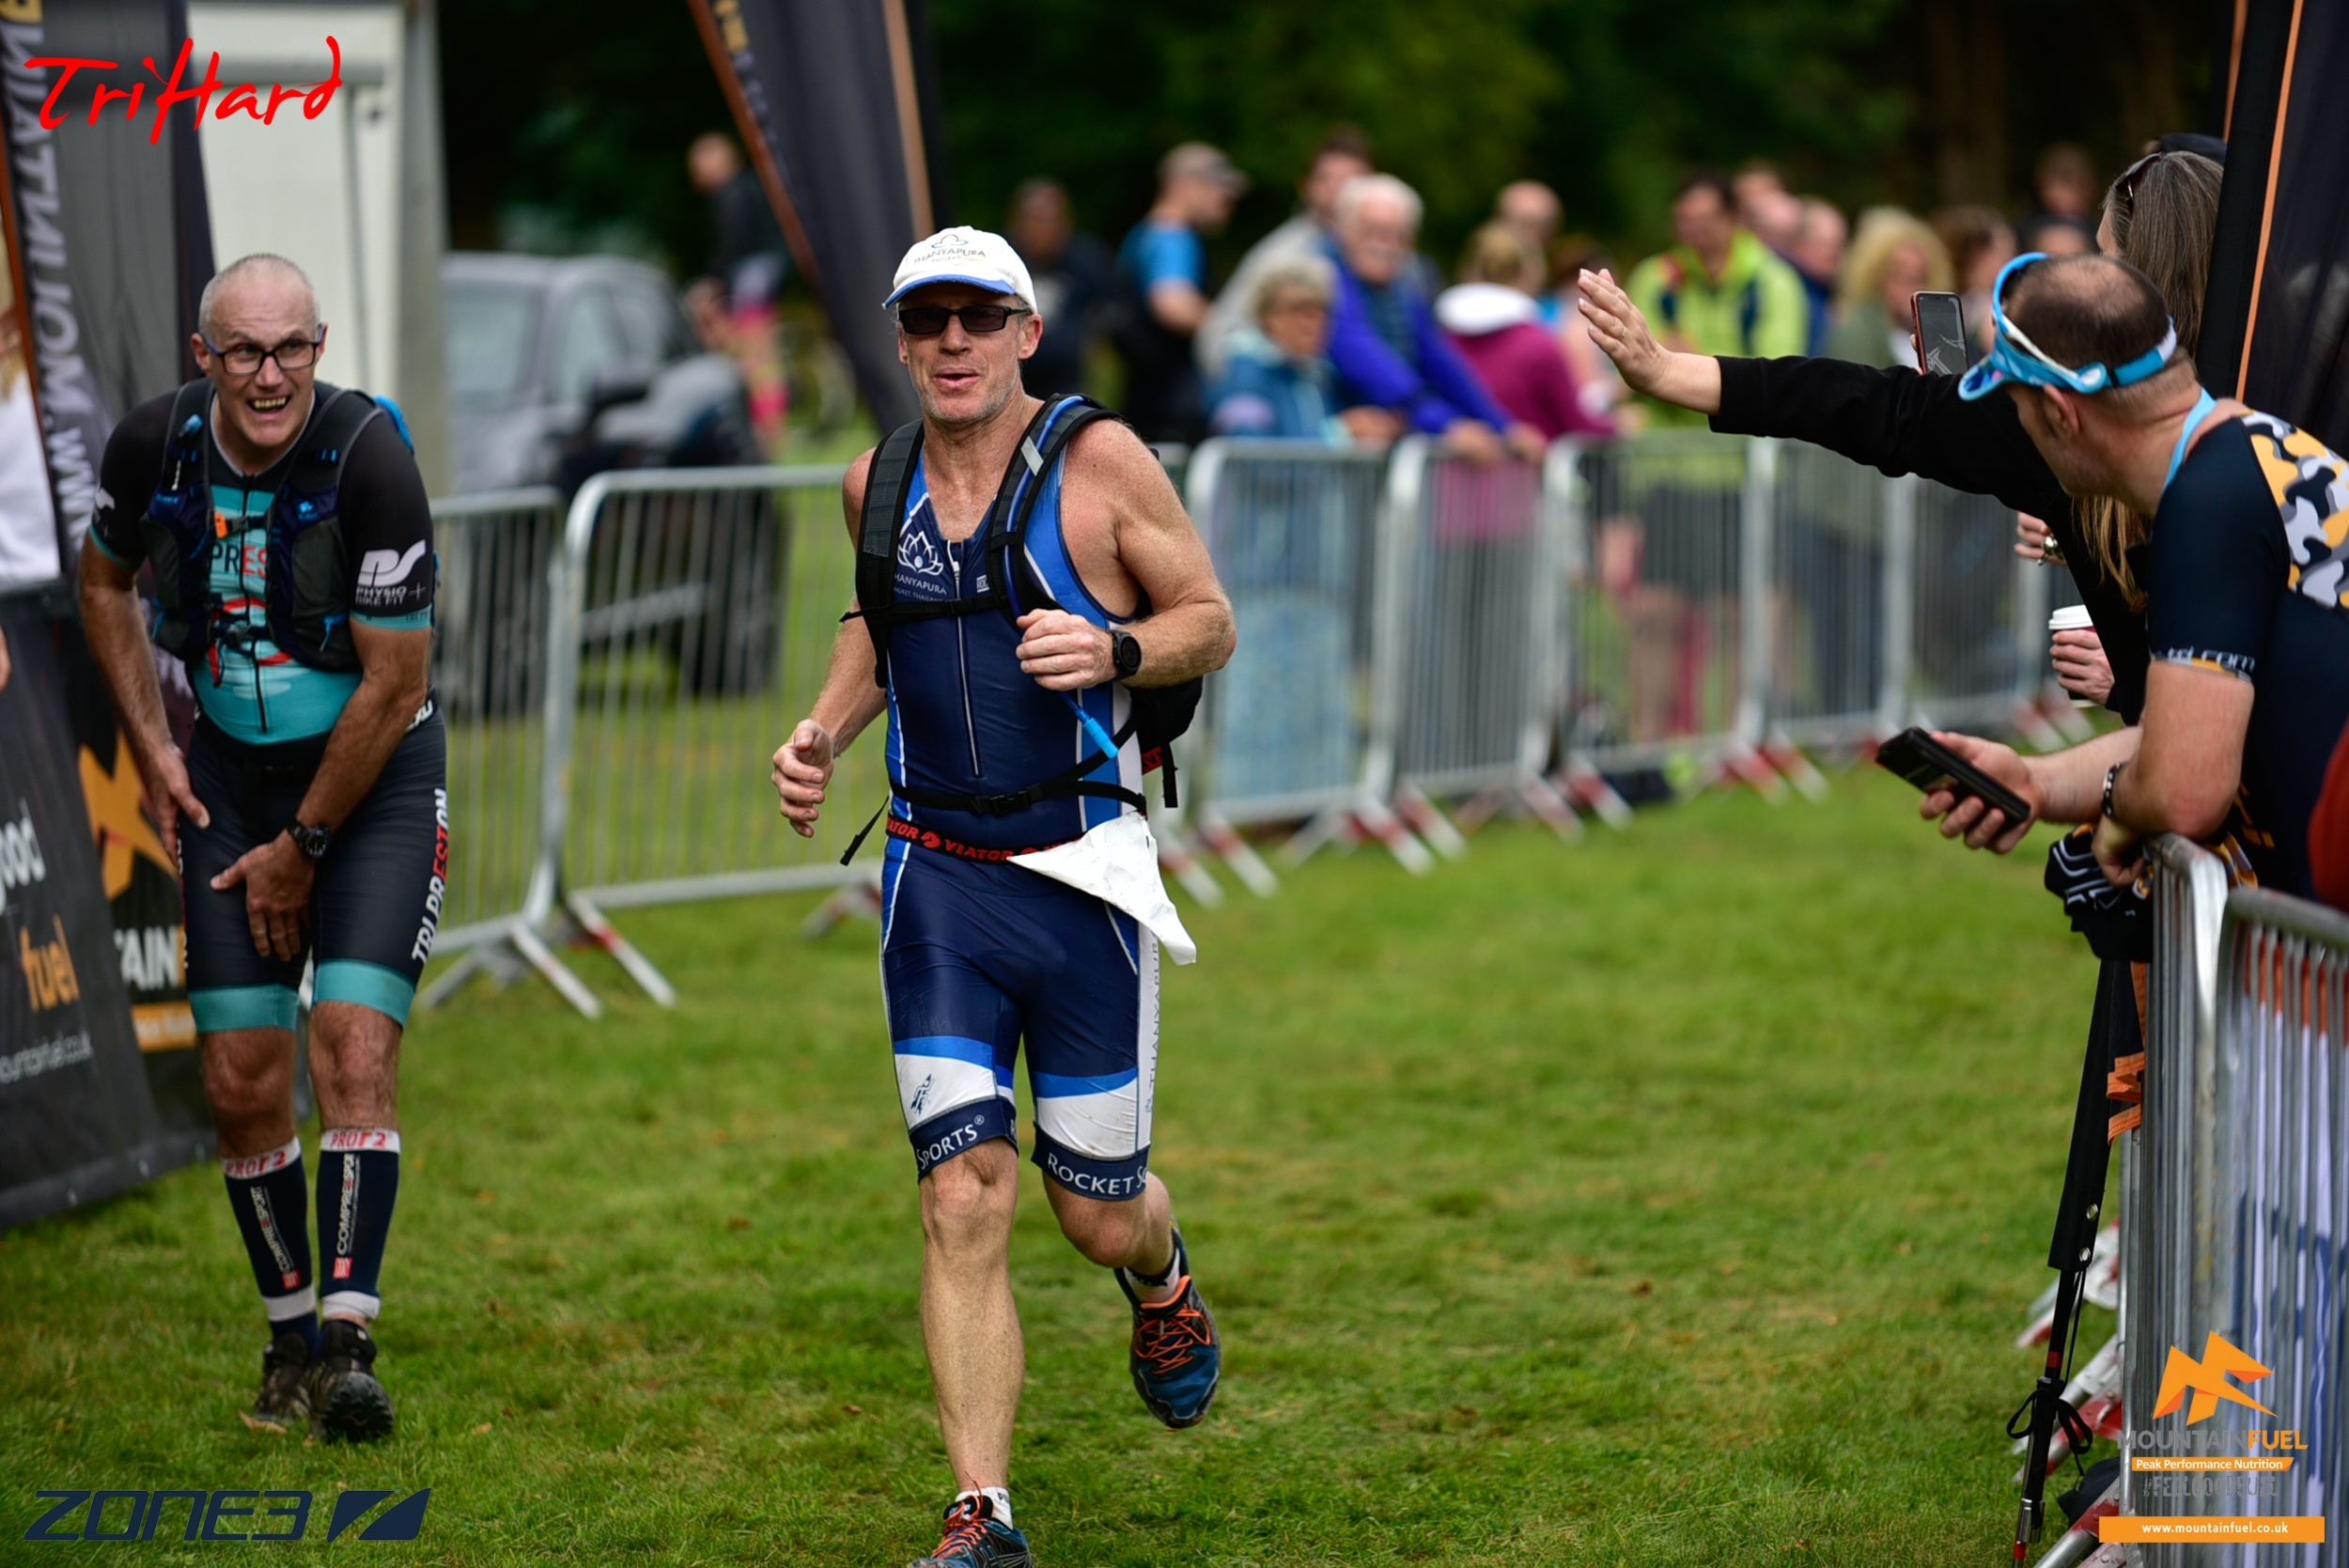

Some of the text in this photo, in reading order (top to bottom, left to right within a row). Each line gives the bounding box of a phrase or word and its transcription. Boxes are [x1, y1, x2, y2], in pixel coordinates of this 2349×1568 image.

[913, 247, 987, 265] THANYAPURA
[211, 543, 269, 580] PRES
[355, 585, 408, 598] PHYSIO
[894, 573, 947, 596] HANYAPURA
[976, 578, 988, 590] ROC
[888, 818, 1015, 862] ATOR VIATOR
[20, 913, 80, 1014] fuel
[1048, 1152, 1132, 1196] ROCKET
